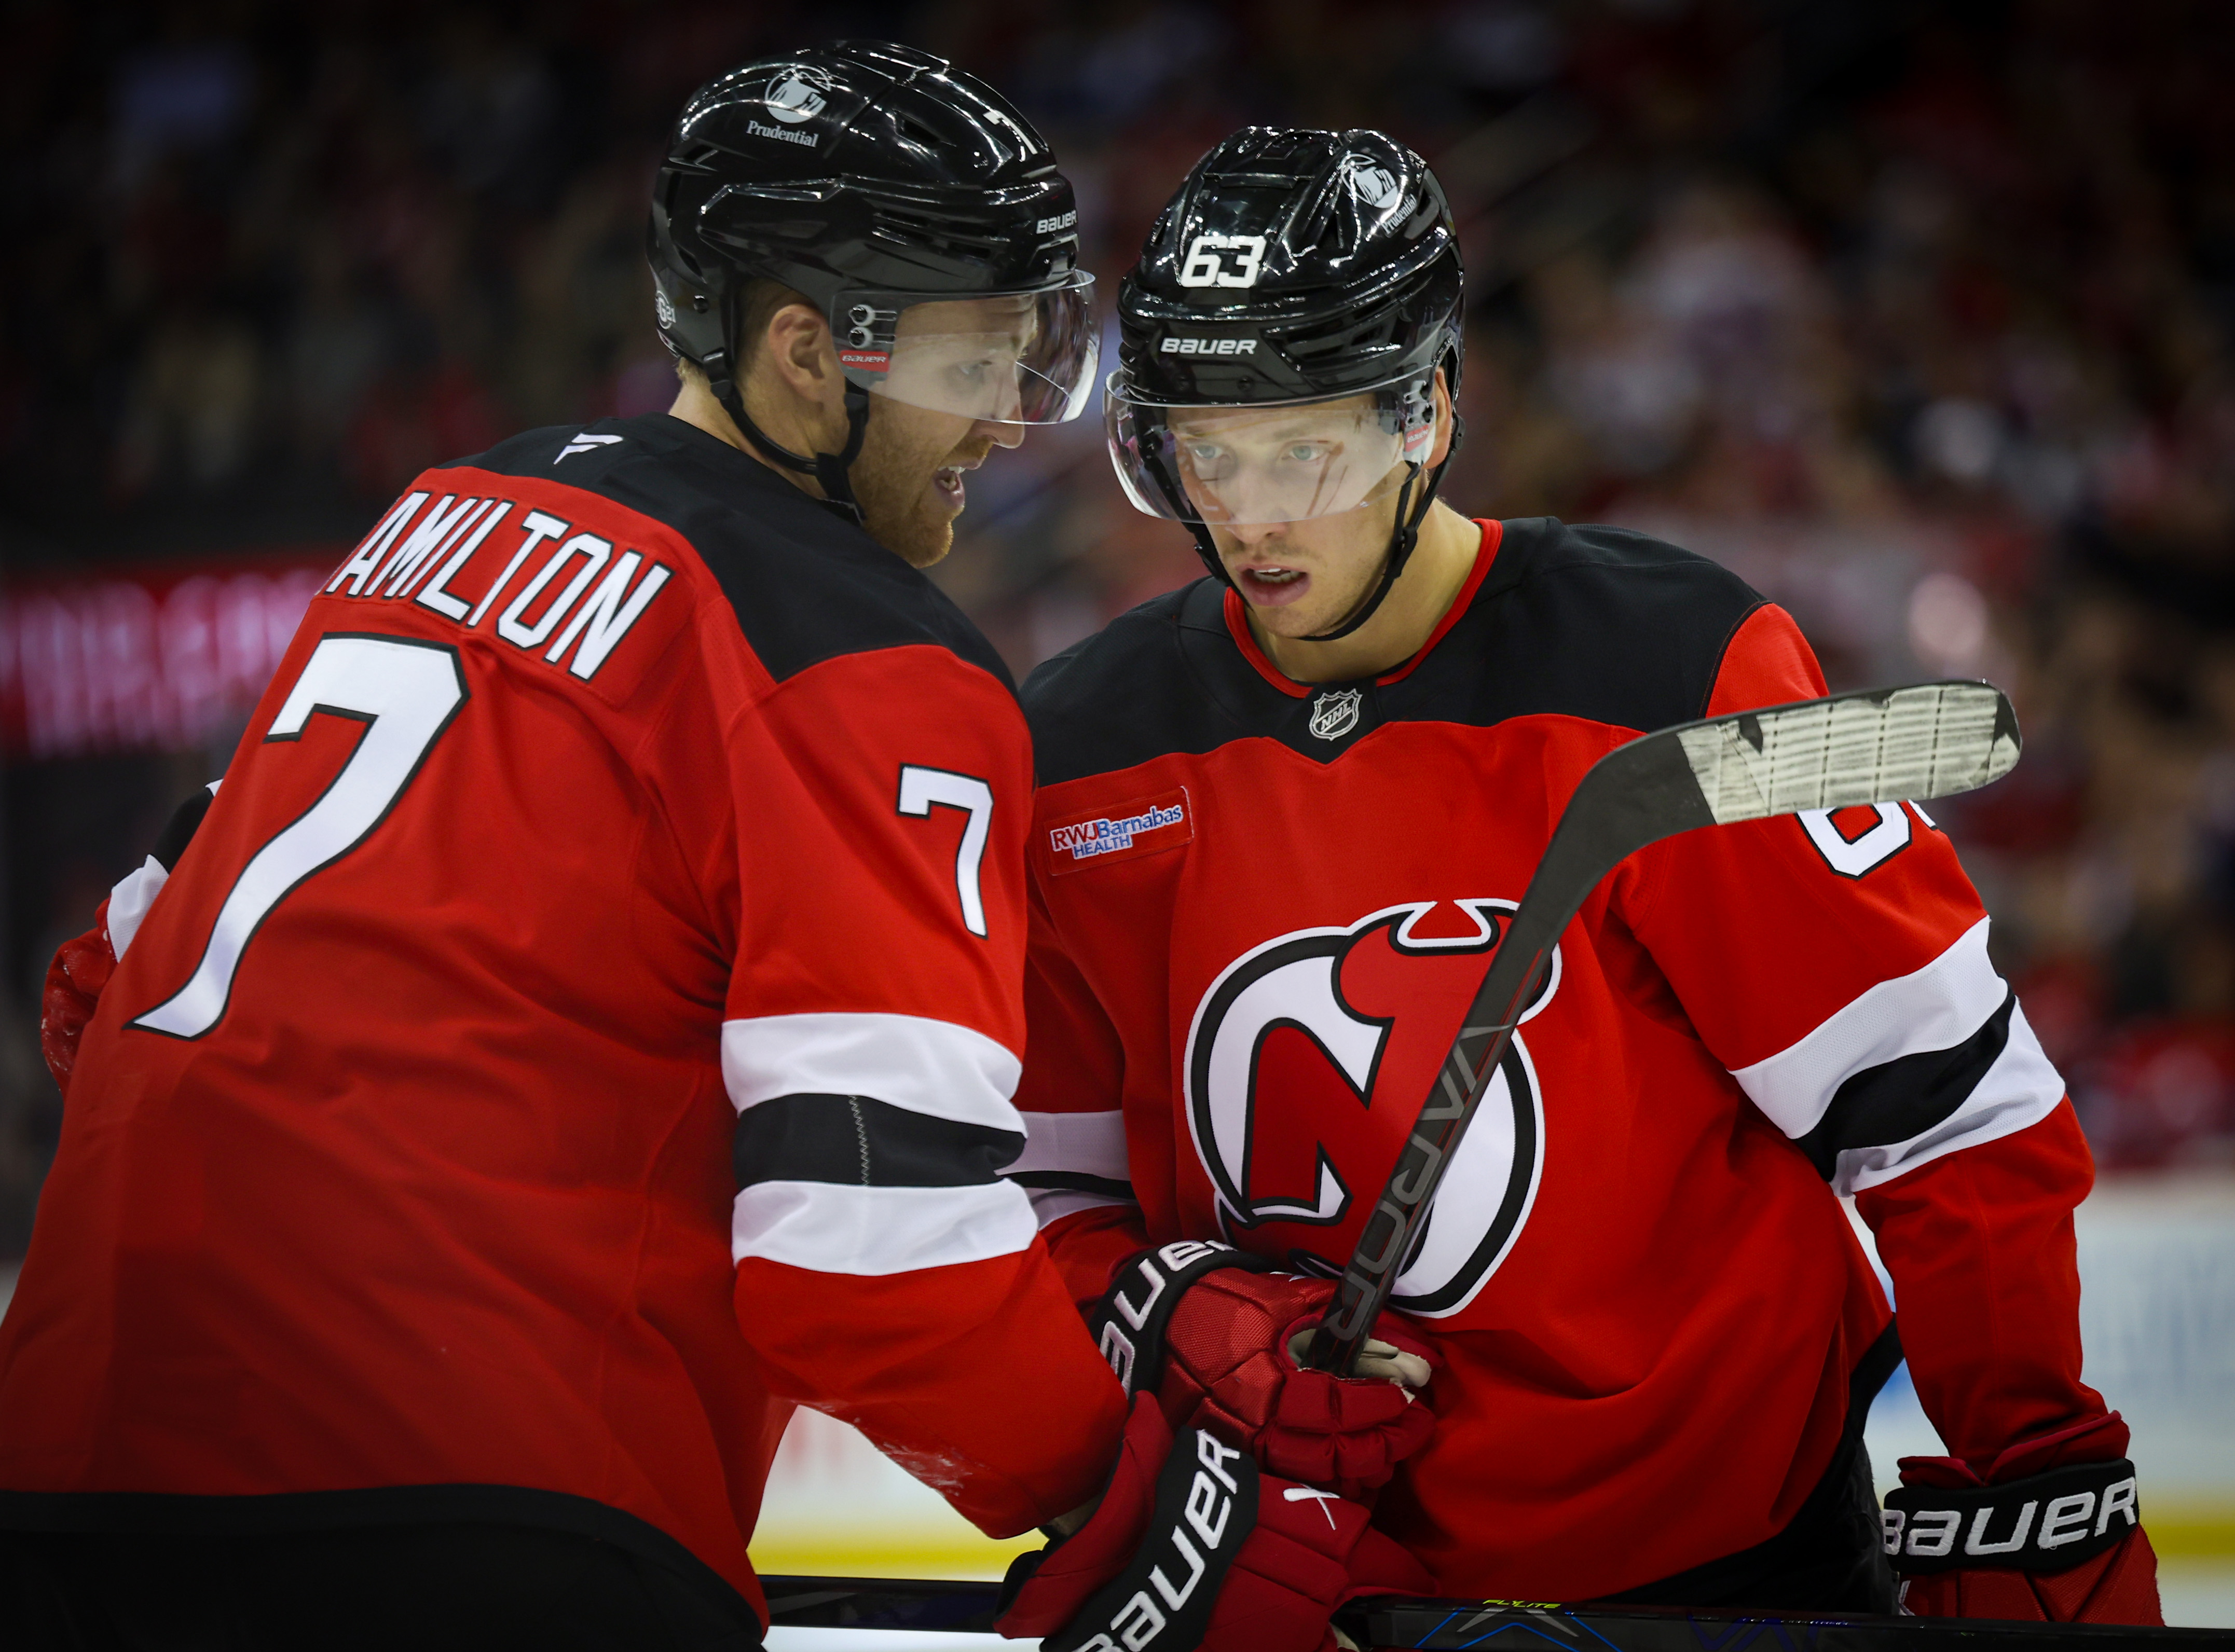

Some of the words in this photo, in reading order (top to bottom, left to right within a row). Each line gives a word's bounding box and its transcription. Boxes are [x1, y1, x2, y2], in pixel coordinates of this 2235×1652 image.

[746, 120, 819, 147] Prudential
[982, 109, 1038, 155] 7
[1036, 210, 1077, 234] BAUER
[1380, 193, 1417, 235] Prudential
[1180, 235, 1267, 288] 63
[842, 354, 886, 363] BAUER
[1160, 337, 1257, 355] BAUER
[323, 490, 675, 682] AMILTON
[1320, 703, 1351, 731] NHL
[122, 632, 471, 1041] 7
[896, 763, 993, 939] 7
[1050, 805, 1183, 851] RWJBarnabas
[1073, 833, 1133, 859] HEALTH
[1326, 1023, 1515, 1341] VAPOR
[1100, 1240, 1238, 1400] AUE
[1879, 1477, 2137, 1557] BAUER
[1482, 1596, 1561, 1608] FLYLITE
